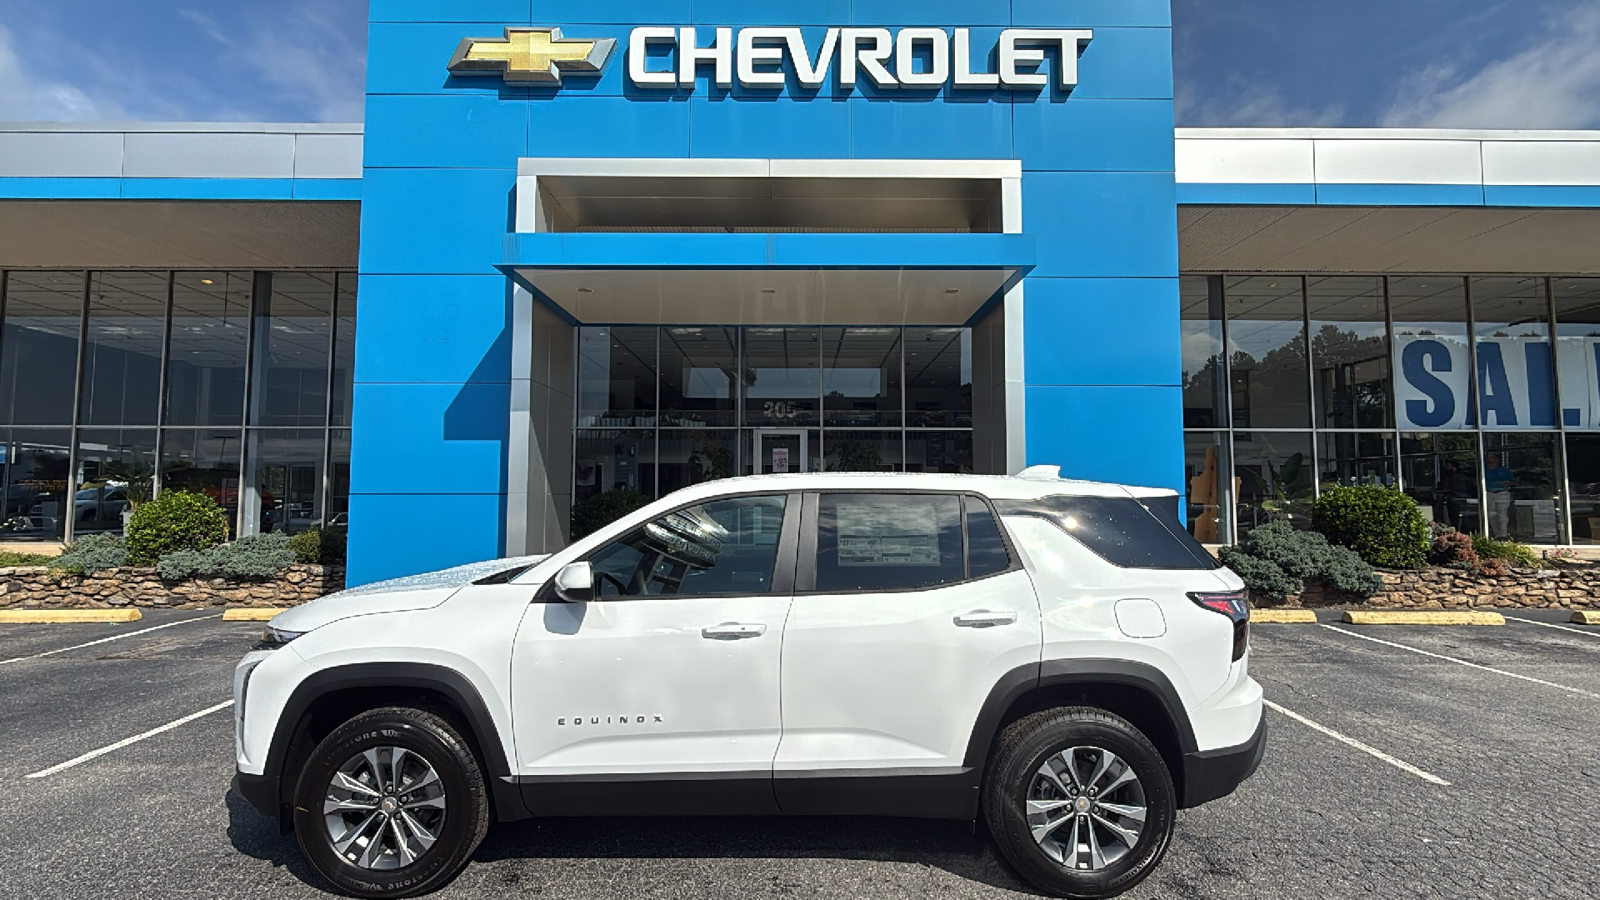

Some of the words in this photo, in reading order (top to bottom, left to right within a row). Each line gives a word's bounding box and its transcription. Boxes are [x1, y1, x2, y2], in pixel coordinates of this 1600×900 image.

[629, 26, 1093, 87] CHEVROLET
[1402, 340, 1600, 427] SAL
[763, 401, 798, 419] 205
[557, 714, 662, 726] EQUINOX
